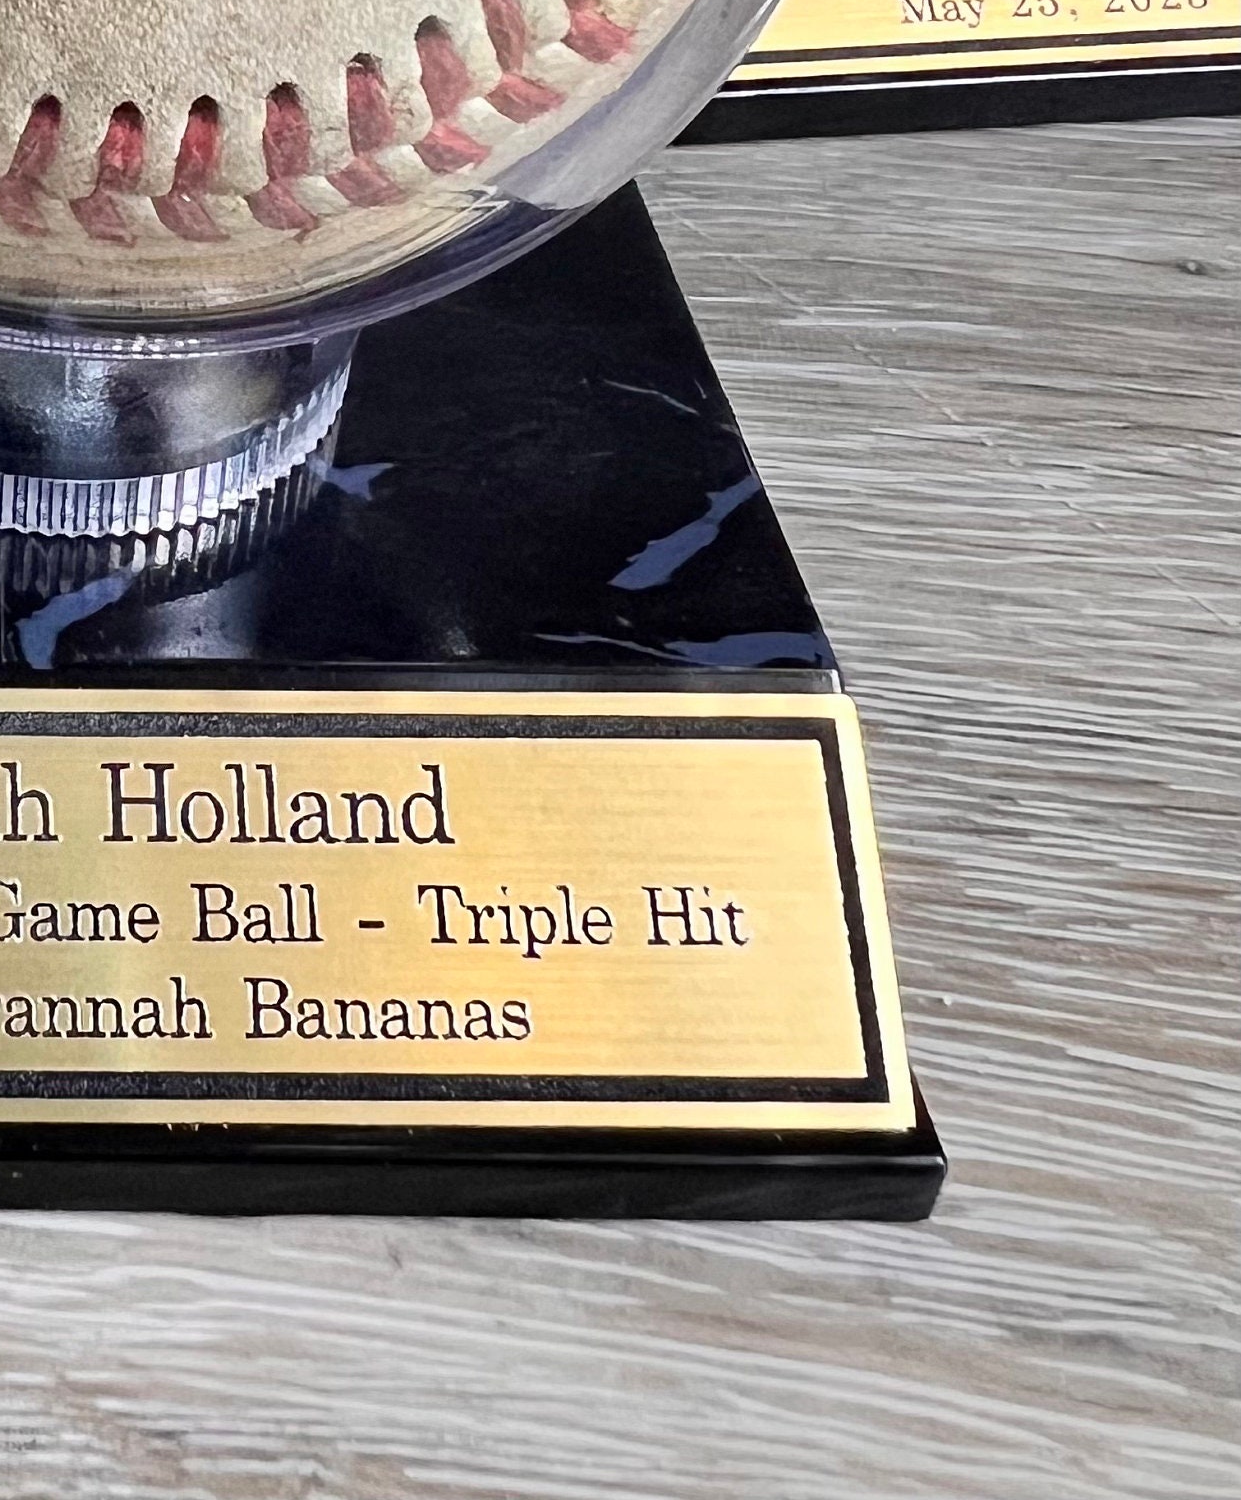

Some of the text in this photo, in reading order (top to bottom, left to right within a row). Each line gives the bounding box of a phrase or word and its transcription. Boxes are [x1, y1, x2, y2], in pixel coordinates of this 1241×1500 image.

[101, 761, 454, 844] Holland
[191, 884, 323, 943] Ball
[418, 885, 613, 959] Triple
[648, 887, 750, 946] Hit
[244, 978, 531, 1041] Bananas
